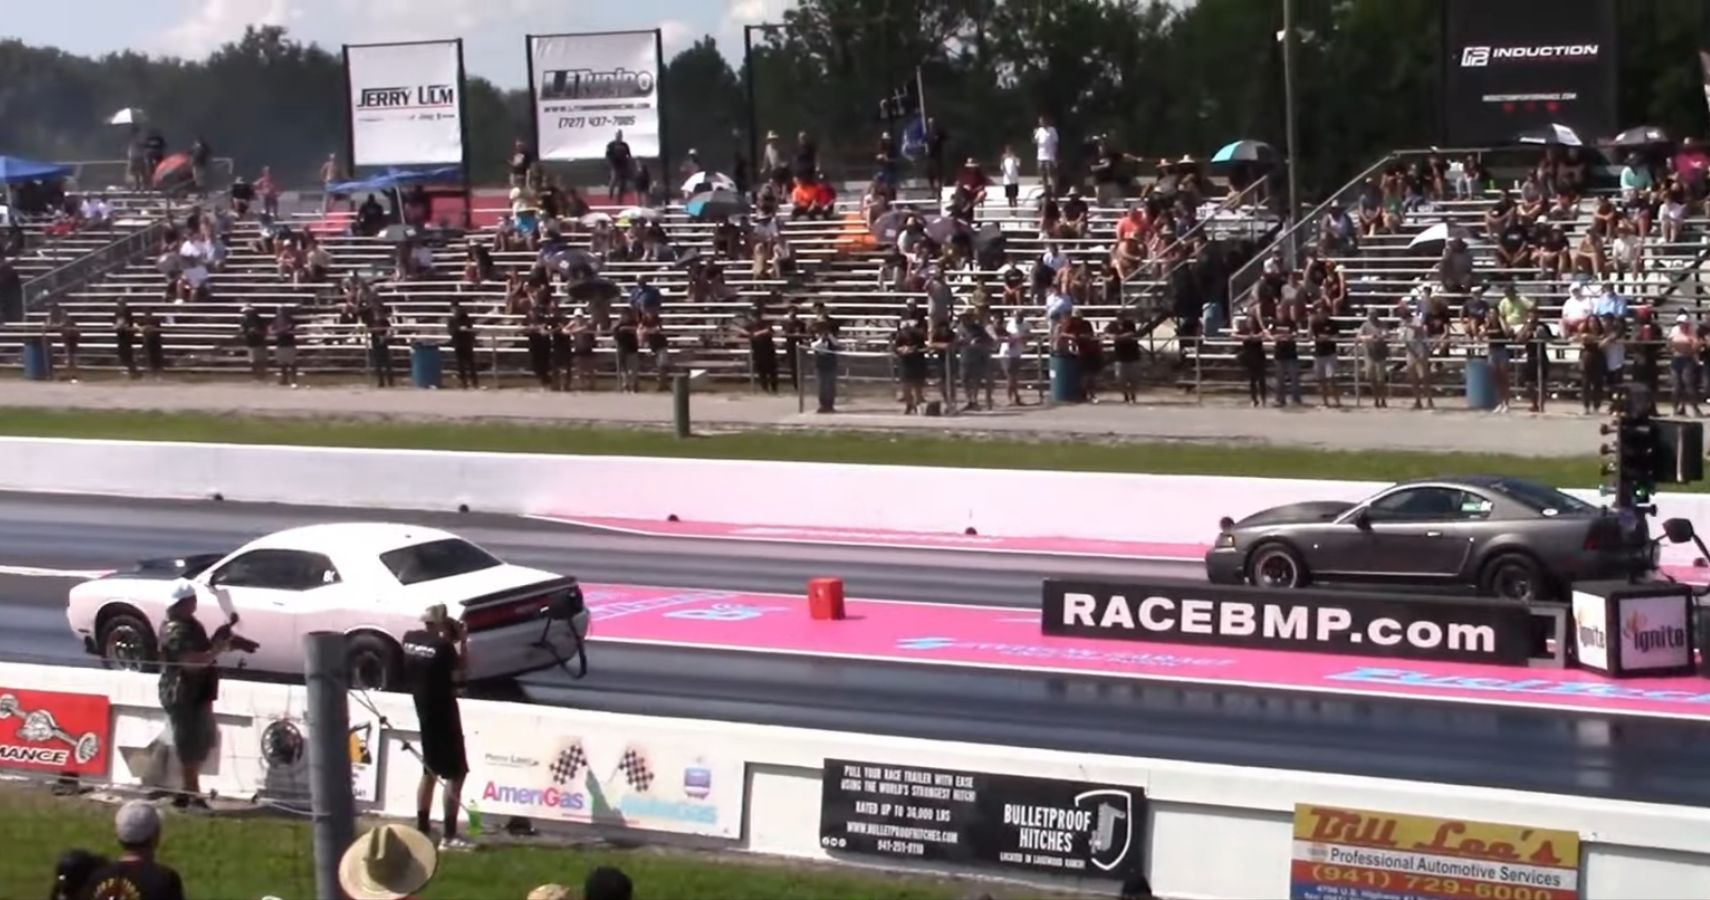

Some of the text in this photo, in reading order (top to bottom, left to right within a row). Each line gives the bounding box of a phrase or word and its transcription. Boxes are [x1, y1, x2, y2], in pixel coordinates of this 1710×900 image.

[1493, 45, 1598, 58] INDUCTION
[357, 85, 453, 107] JERRY ULM
[1063, 592, 1496, 653] RACEBMP.com
[841, 778, 861, 791] USING
[864, 780, 877, 793] THE
[879, 782, 909, 796] WORLD'S
[911, 785, 951, 800] STRONGEST
[844, 765, 973, 788] PULL YOUR RACE TRAILER WITH EASE
[483, 781, 584, 810] AmeriGas
[856, 801, 878, 815] RATED
[881, 803, 891, 816] UP
[894, 804, 903, 817] TO
[936, 809, 951, 822] LBS
[1004, 804, 1091, 831] BULLETPROOF
[846, 821, 958, 843] WWW.BULLETPROOFHITCHES.COM
[1020, 827, 1073, 853] HITCHES
[1310, 808, 1563, 864] Bill Lee's
[1330, 847, 1561, 887] Professional Automotive Services
[1312, 864, 1553, 900] (941) 729-6000
